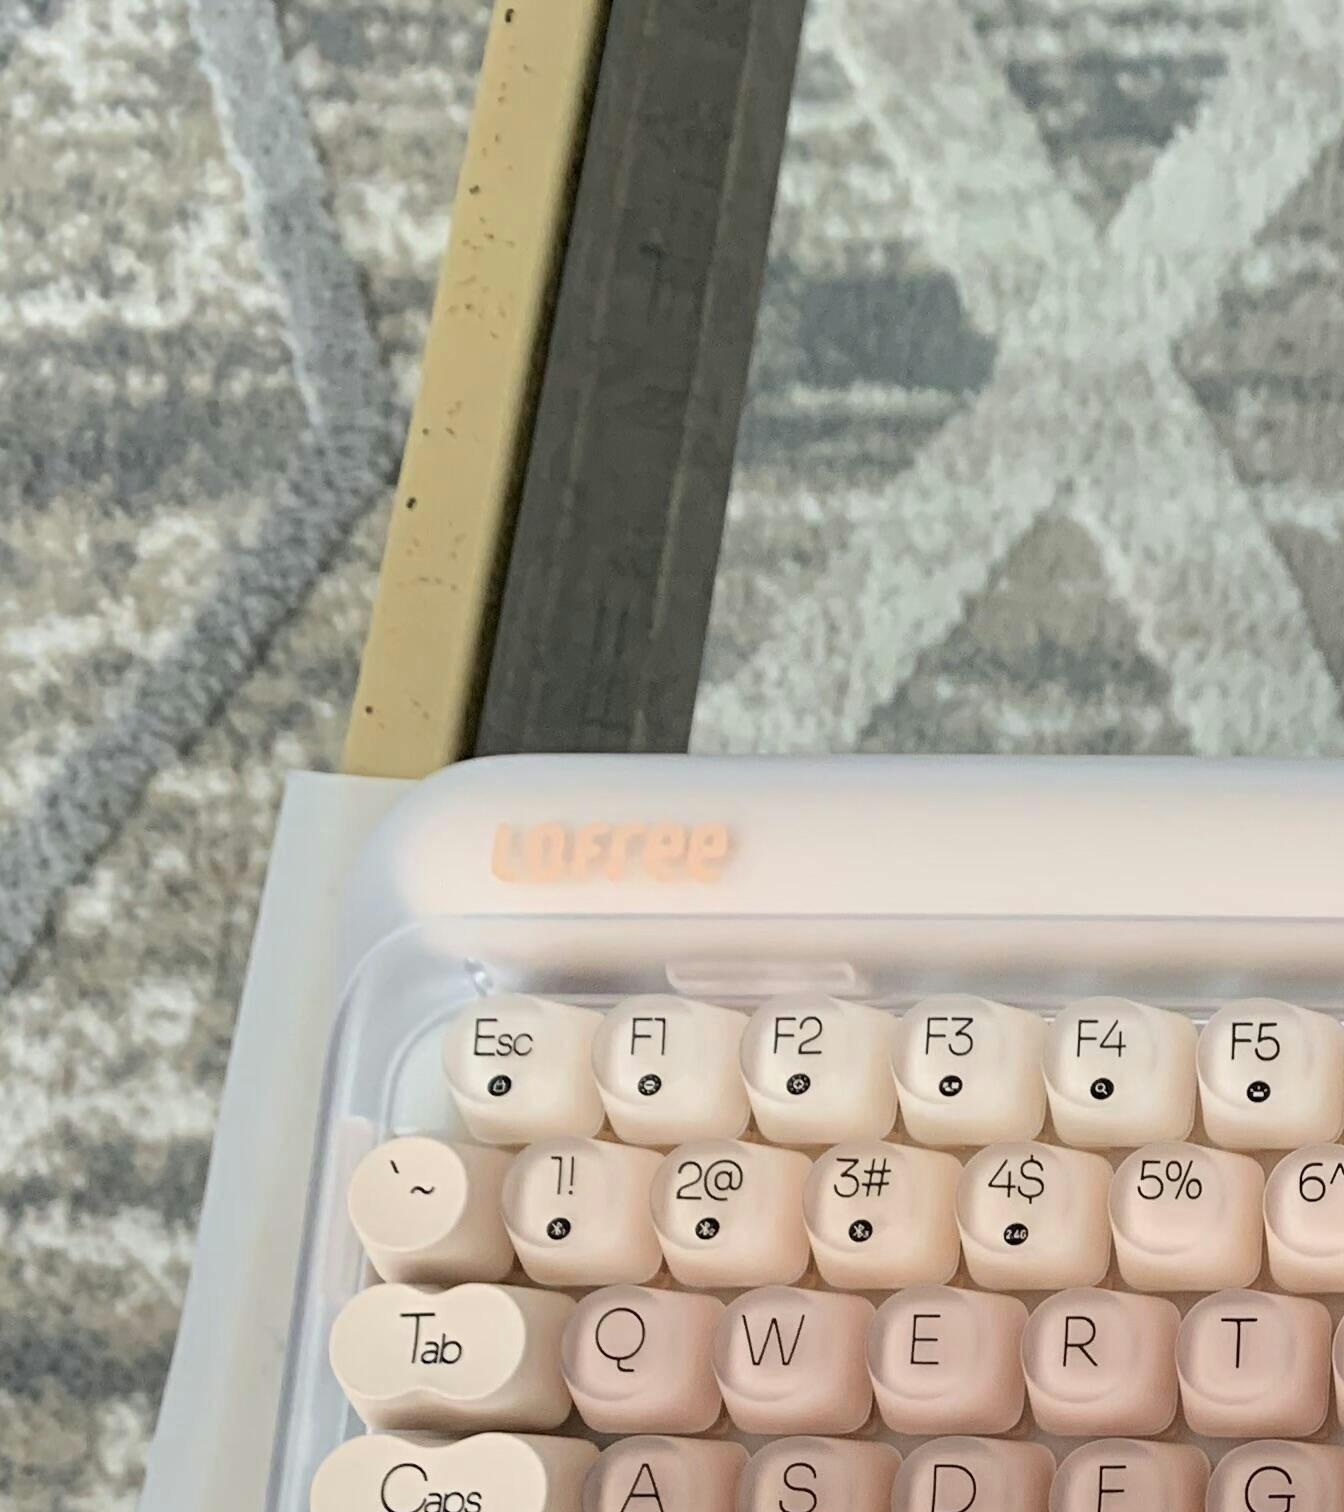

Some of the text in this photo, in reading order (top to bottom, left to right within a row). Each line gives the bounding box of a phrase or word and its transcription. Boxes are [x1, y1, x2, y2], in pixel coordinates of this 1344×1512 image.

[473, 1017, 534, 1057] Esc
[630, 1017, 667, 1056] F1
[773, 1016, 823, 1055] F2
[925, 1016, 974, 1057] F3
[1076, 1019, 1127, 1058] F4
[1230, 1022, 1281, 1062] F5
[675, 1159, 744, 1202] 2@
[833, 1157, 892, 1199] 3#
[987, 1154, 1045, 1205] 4$
[1137, 1159, 1203, 1201] 5%
[399, 1312, 463, 1365] Tab
[595, 1307, 646, 1373] Q
[741, 1314, 806, 1366] W
[910, 1313, 941, 1366] E
[1062, 1315, 1098, 1368] R
[1220, 1317, 1258, 1369] T
